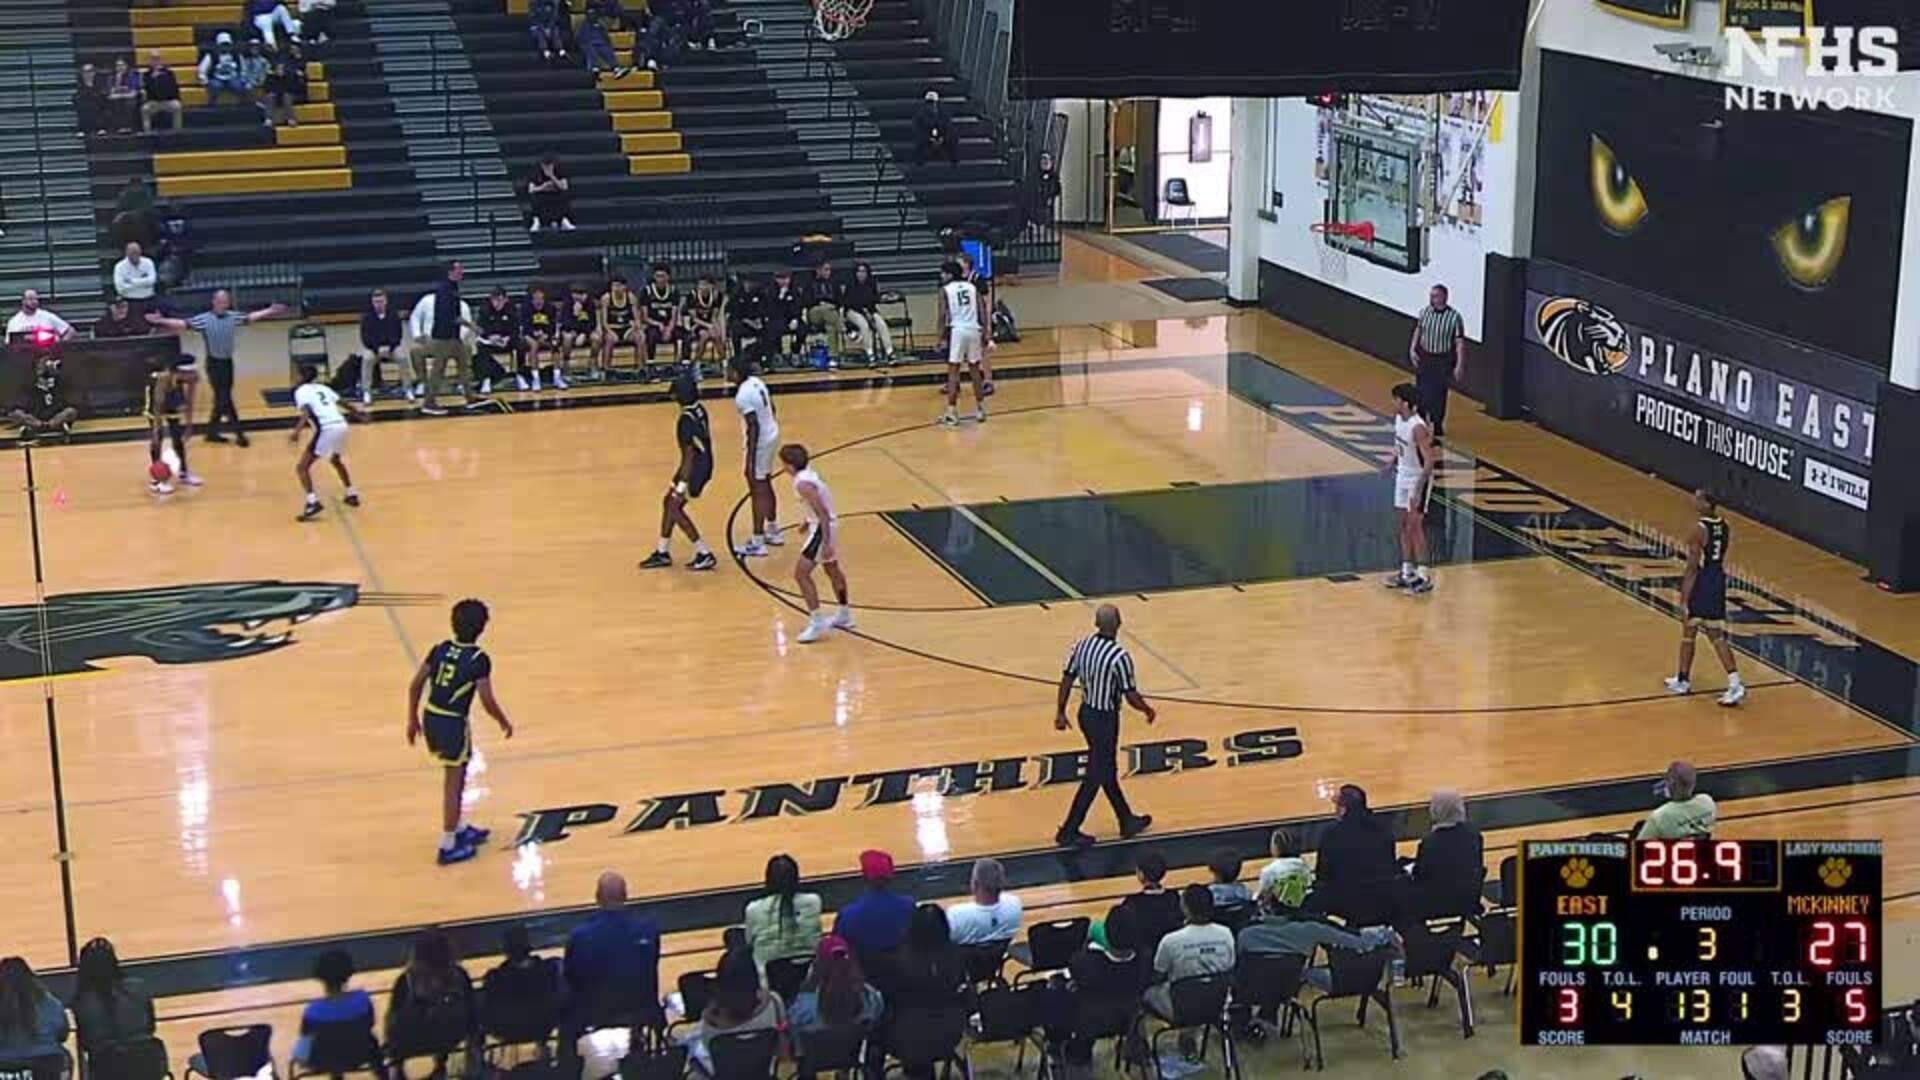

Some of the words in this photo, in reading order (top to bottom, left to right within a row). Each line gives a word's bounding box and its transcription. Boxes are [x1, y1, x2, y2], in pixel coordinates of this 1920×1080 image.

[957, 290, 970, 306] 15
[1639, 335, 1753, 413] PLANO
[1636, 394, 1702, 445] PROTECT
[1705, 419, 1734, 458] THIS
[1837, 478, 1867, 500] WILL
[1712, 540, 1721, 560] 3
[436, 661, 456, 687] 12
